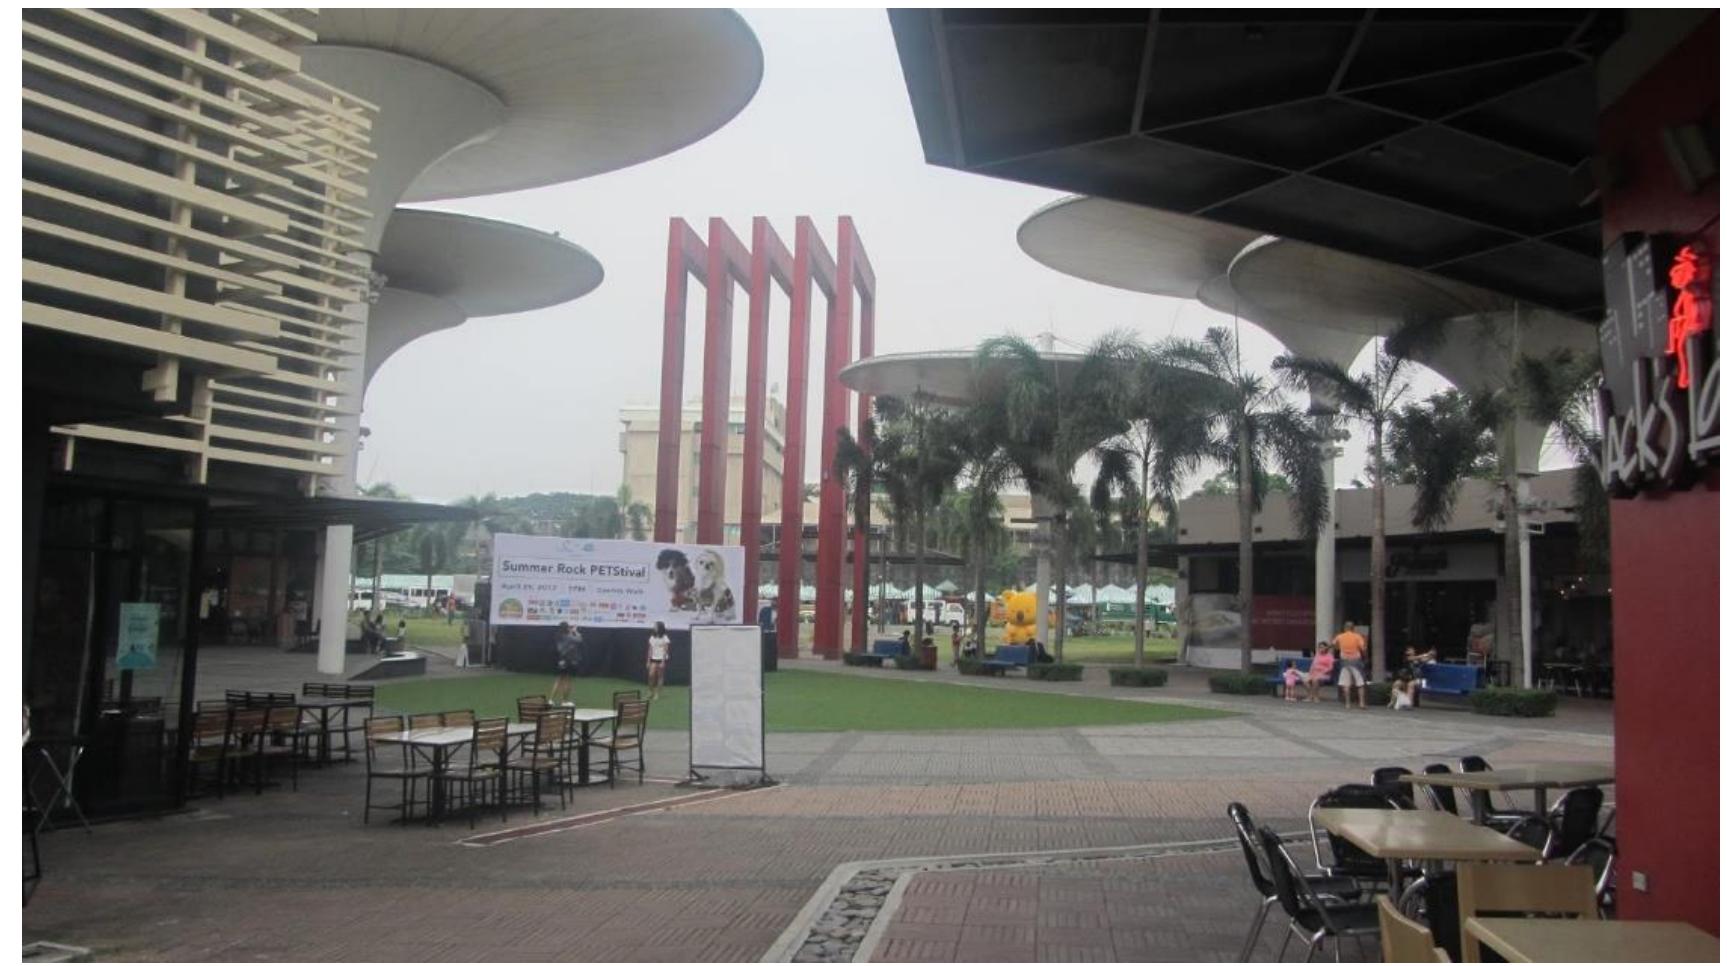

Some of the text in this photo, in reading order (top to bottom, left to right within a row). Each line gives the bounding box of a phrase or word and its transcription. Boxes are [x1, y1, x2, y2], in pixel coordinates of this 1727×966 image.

[502, 560, 646, 578] Summer Rock PETStival
